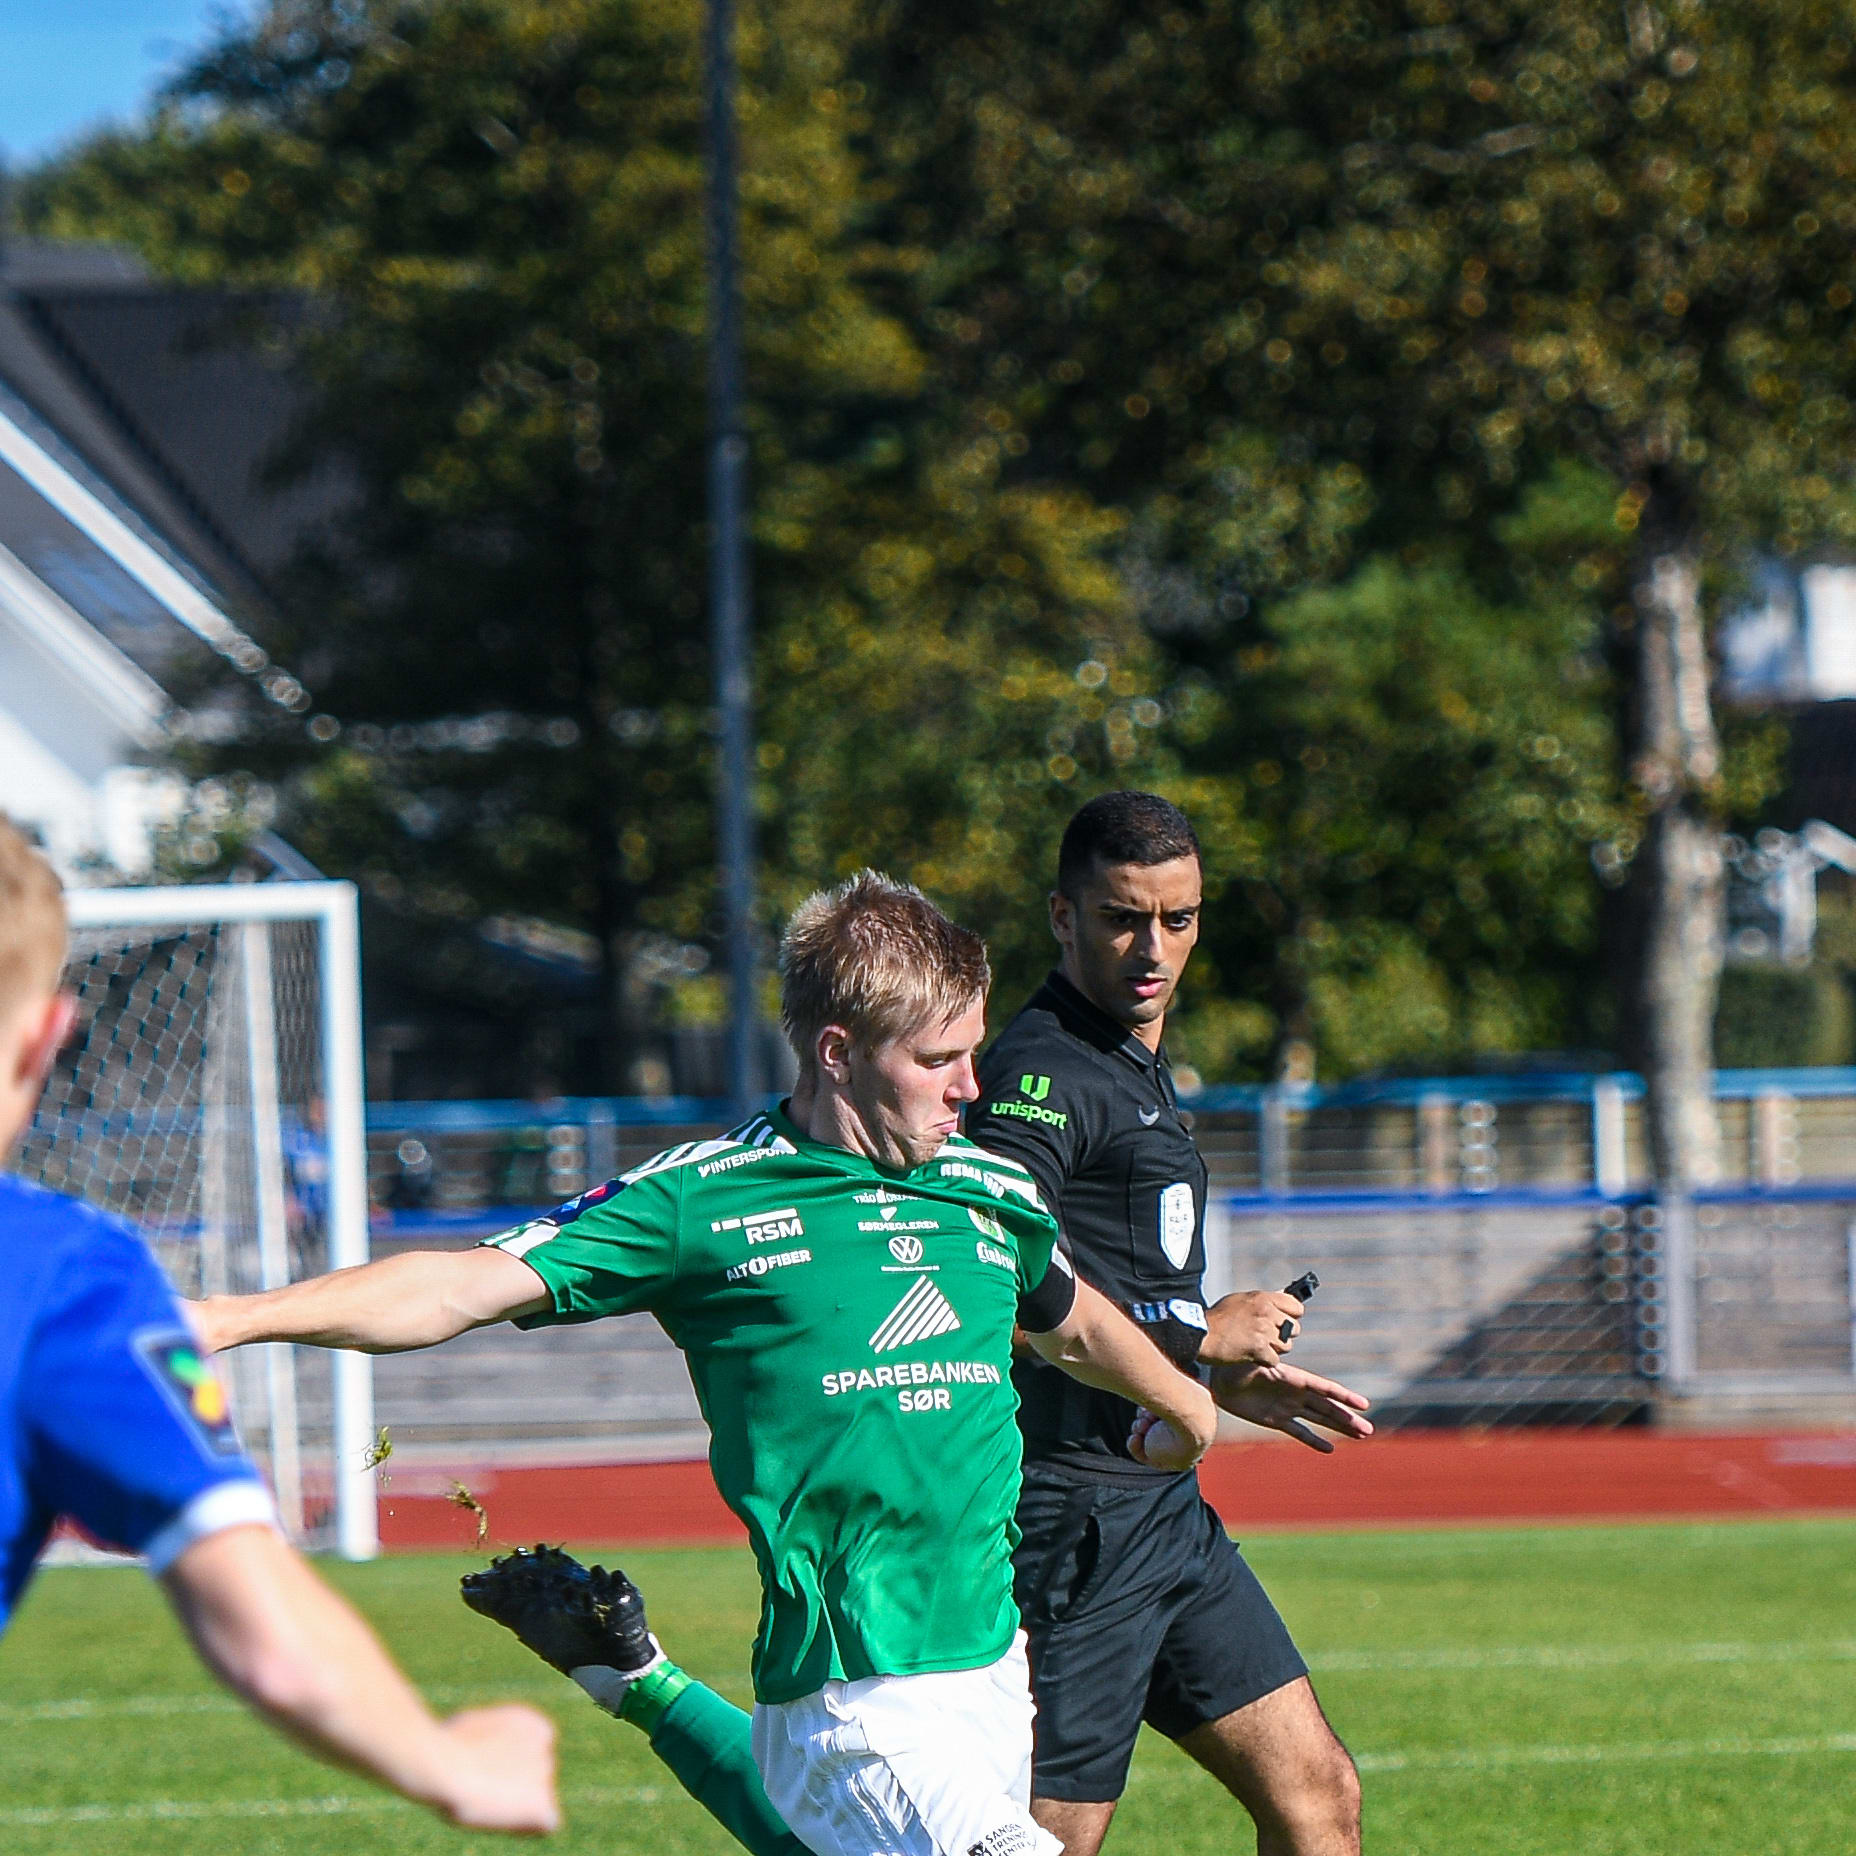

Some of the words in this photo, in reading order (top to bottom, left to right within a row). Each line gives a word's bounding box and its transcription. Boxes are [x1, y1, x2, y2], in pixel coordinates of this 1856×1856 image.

[990, 1100, 1068, 1130] unisport
[711, 1147, 790, 1175] INTERSPOR
[745, 1218, 804, 1245] RSM
[821, 1361, 1001, 1396] SPAREBANKEN
[897, 1388, 952, 1413] SØR
